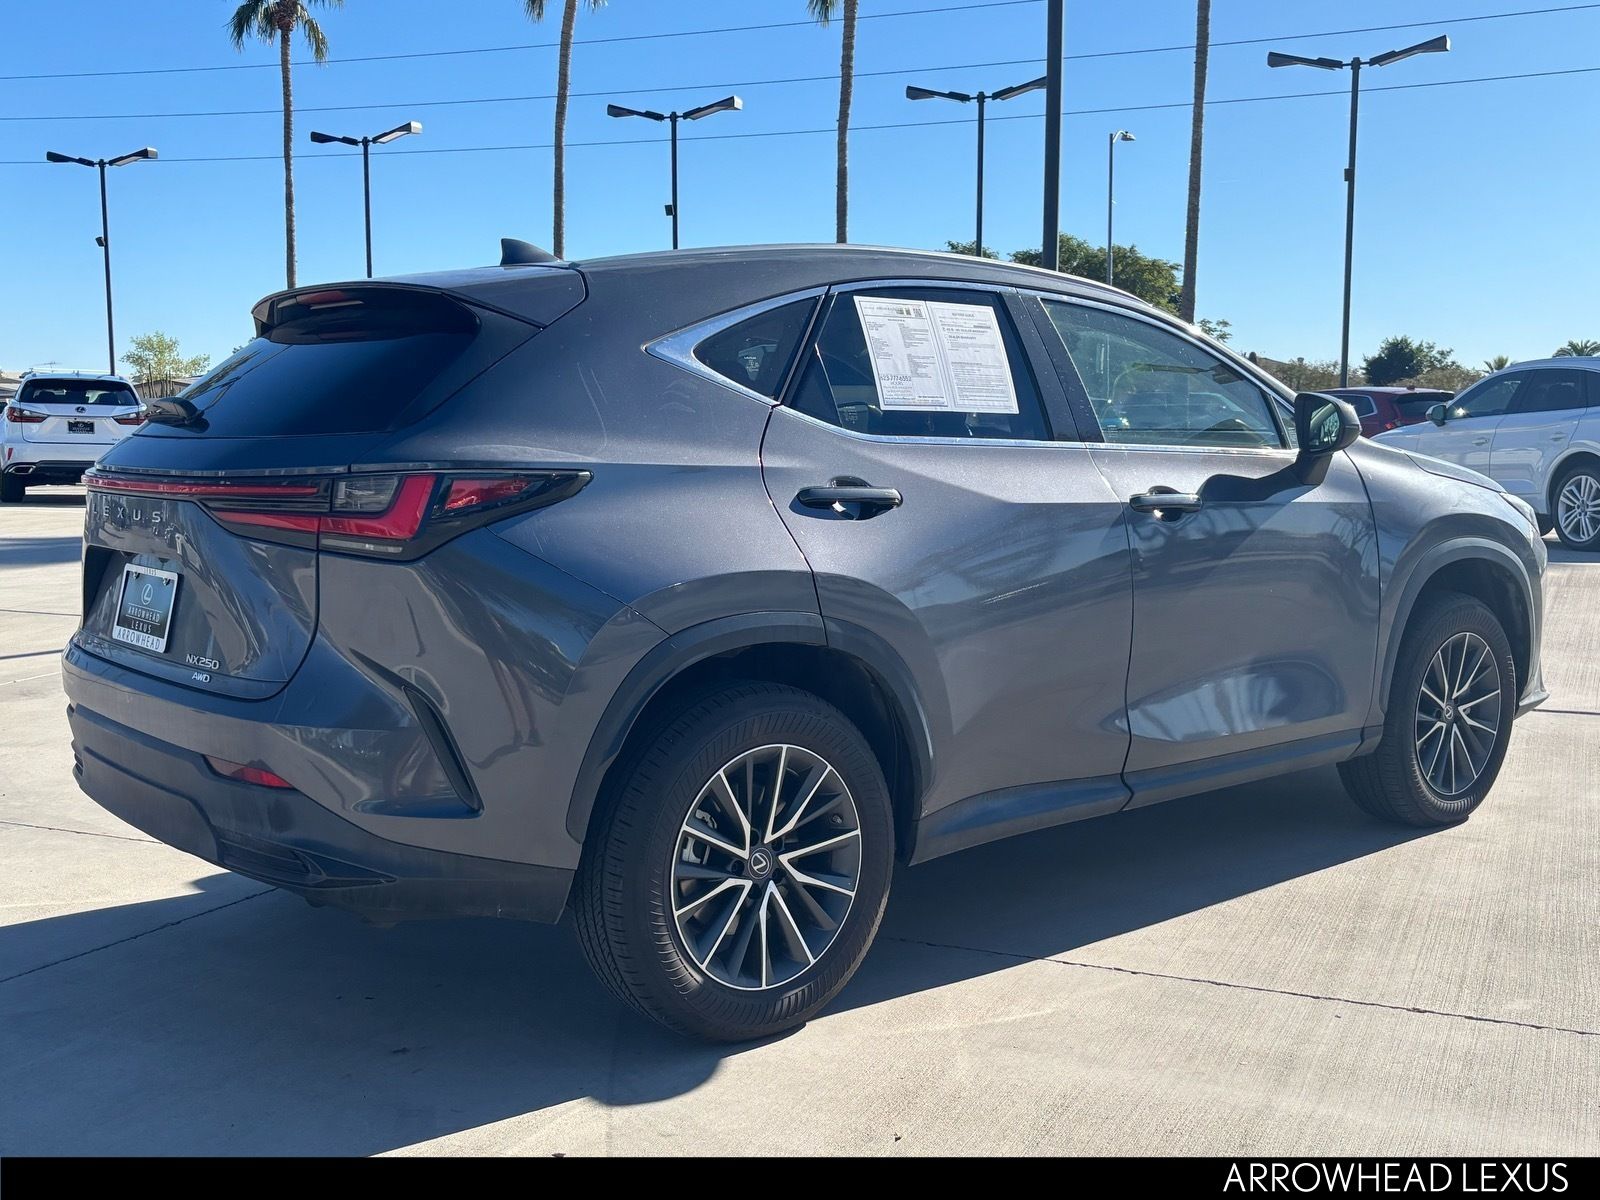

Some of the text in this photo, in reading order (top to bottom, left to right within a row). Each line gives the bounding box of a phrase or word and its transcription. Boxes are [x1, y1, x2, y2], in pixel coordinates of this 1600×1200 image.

[92, 503, 161, 523] LEXUS
[128, 605, 160, 623] ARROWHEAD
[131, 620, 152, 634] LEXUS
[116, 628, 161, 650] ARROWHEAD
[185, 653, 220, 670] NX250
[191, 672, 210, 683] AWD
